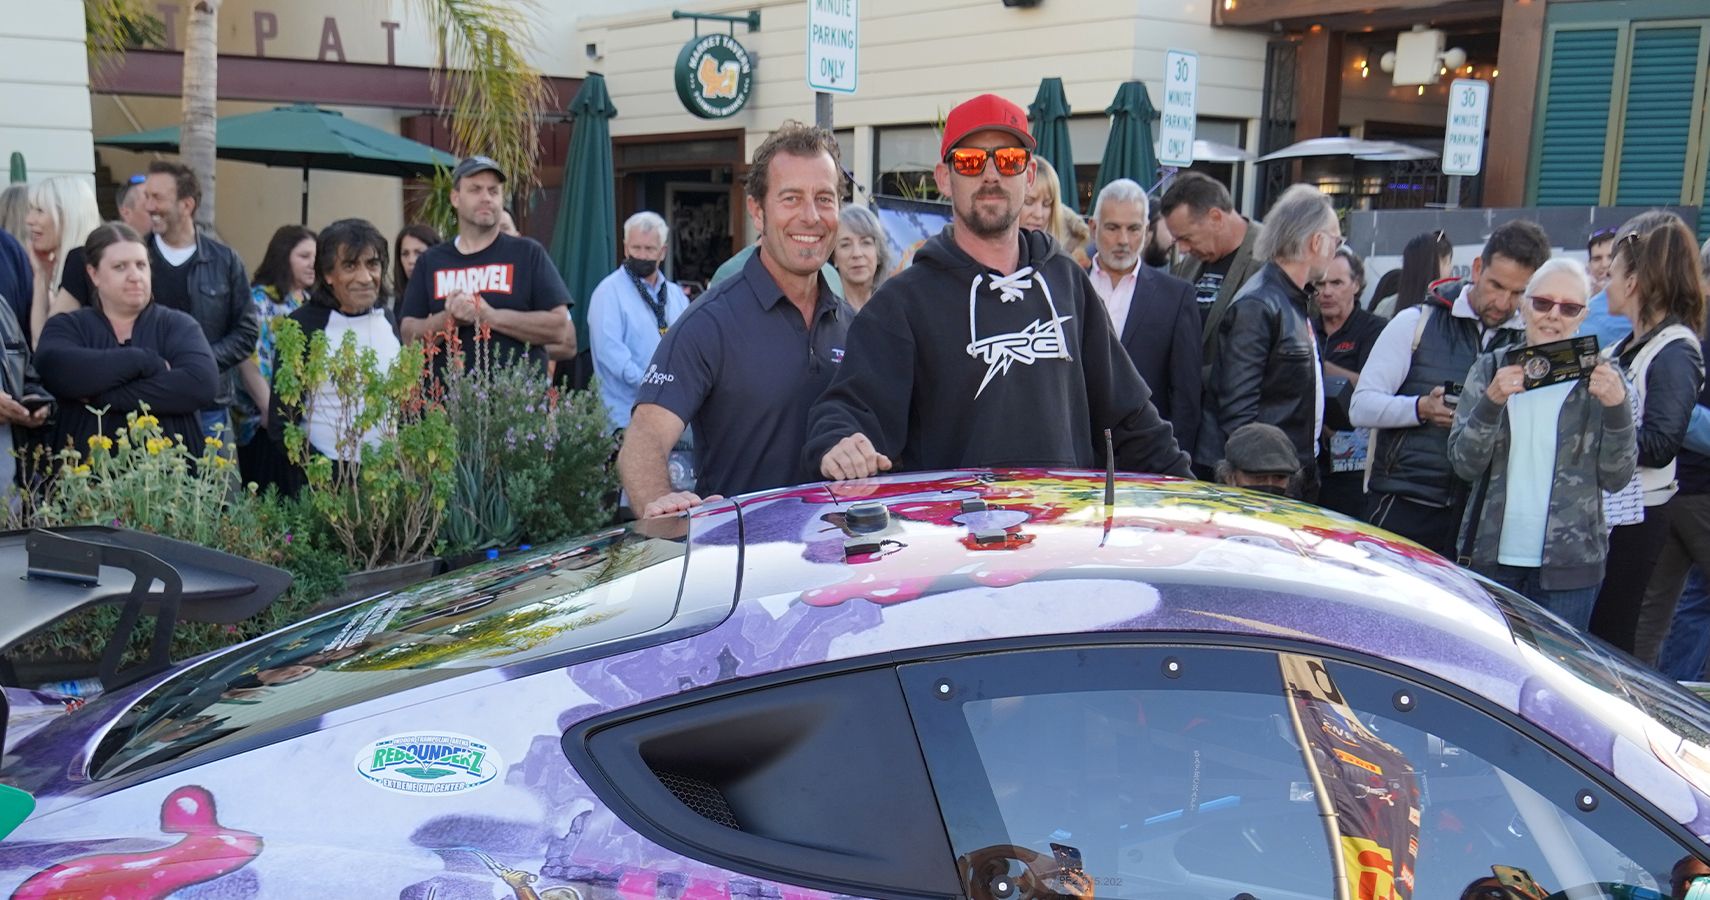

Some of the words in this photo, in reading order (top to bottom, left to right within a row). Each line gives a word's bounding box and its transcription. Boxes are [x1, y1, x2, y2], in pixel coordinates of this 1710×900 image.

[815, 0, 852, 17] MINUTE
[812, 23, 854, 49] PARKING
[688, 35, 720, 69] MARKET
[722, 36, 751, 74] TAVERN
[820, 57, 845, 79] ONLY
[1175, 60, 1189, 82] 30
[1168, 90, 1192, 107] MINUTE
[1461, 90, 1476, 107] 30
[1164, 113, 1192, 132] PARKING
[1453, 113, 1479, 128] MINUTE
[1168, 138, 1185, 155] ONLY
[1449, 132, 1479, 146] PARKING
[1452, 152, 1472, 165] ONLY
[436, 264, 511, 298] MARVEL
[966, 316, 1072, 366] TRG
[370, 744, 485, 777] REBOUNDERZ
[383, 778, 418, 792] EXTREME
[418, 782, 434, 793] FUN
[434, 782, 465, 793] CENTER
